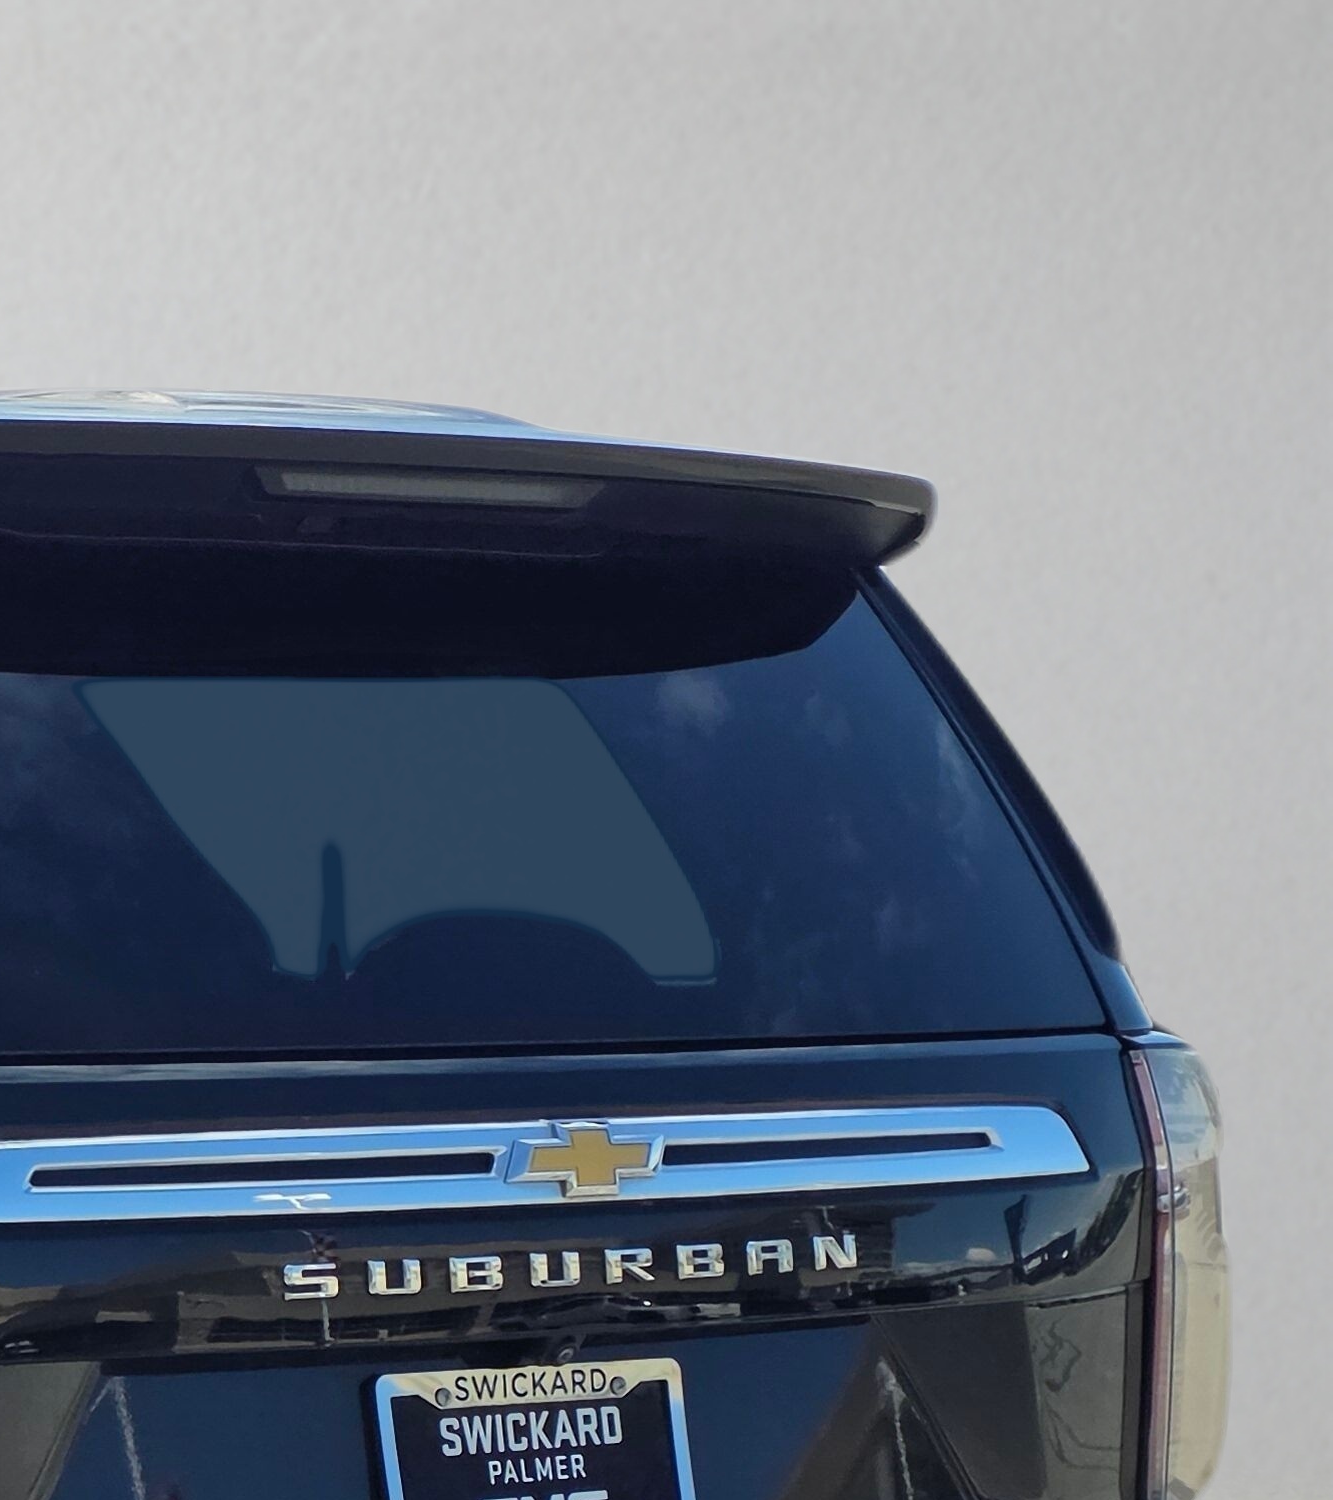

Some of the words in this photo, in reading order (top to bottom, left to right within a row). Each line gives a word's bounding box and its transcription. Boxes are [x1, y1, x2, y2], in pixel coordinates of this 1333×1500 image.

[282, 1233, 859, 1301] SUBURBAN
[454, 1367, 608, 1401] SWICKARD
[439, 1405, 623, 1457] SWICKARD
[487, 1453, 587, 1485] PALMER
